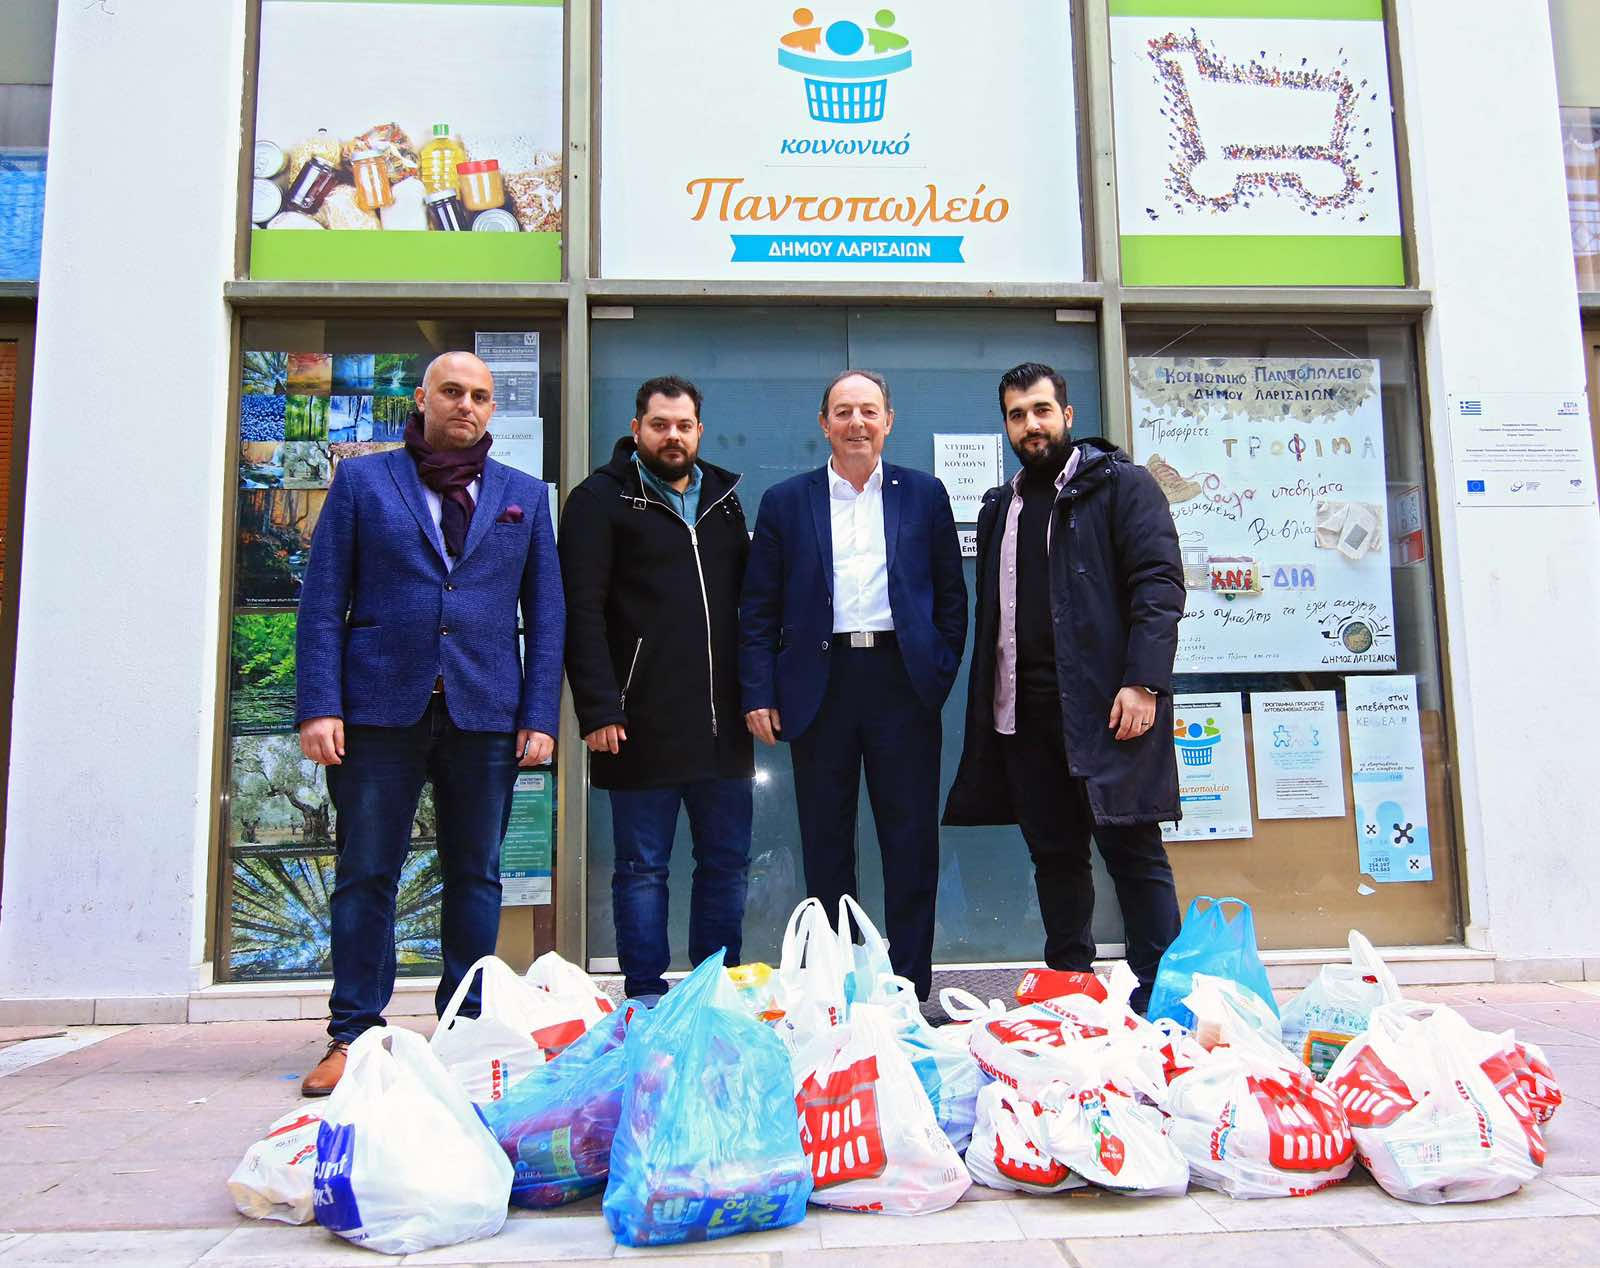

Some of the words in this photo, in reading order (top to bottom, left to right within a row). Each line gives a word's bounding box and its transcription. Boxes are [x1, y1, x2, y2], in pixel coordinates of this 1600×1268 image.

[780, 133, 911, 156] κοινωνικό
[686, 177, 1009, 227] Παντοπωλείο
[768, 241, 833, 257] ΔΗΜΟΥ
[837, 241, 931, 257] ΛΑΡΙΣΑΙΩΝ
[1194, 388, 1243, 400] ΔΗΜΟΥ
[958, 477, 974, 485] ΣΤΟ
[1179, 784, 1230, 794] αντοπωλείο
